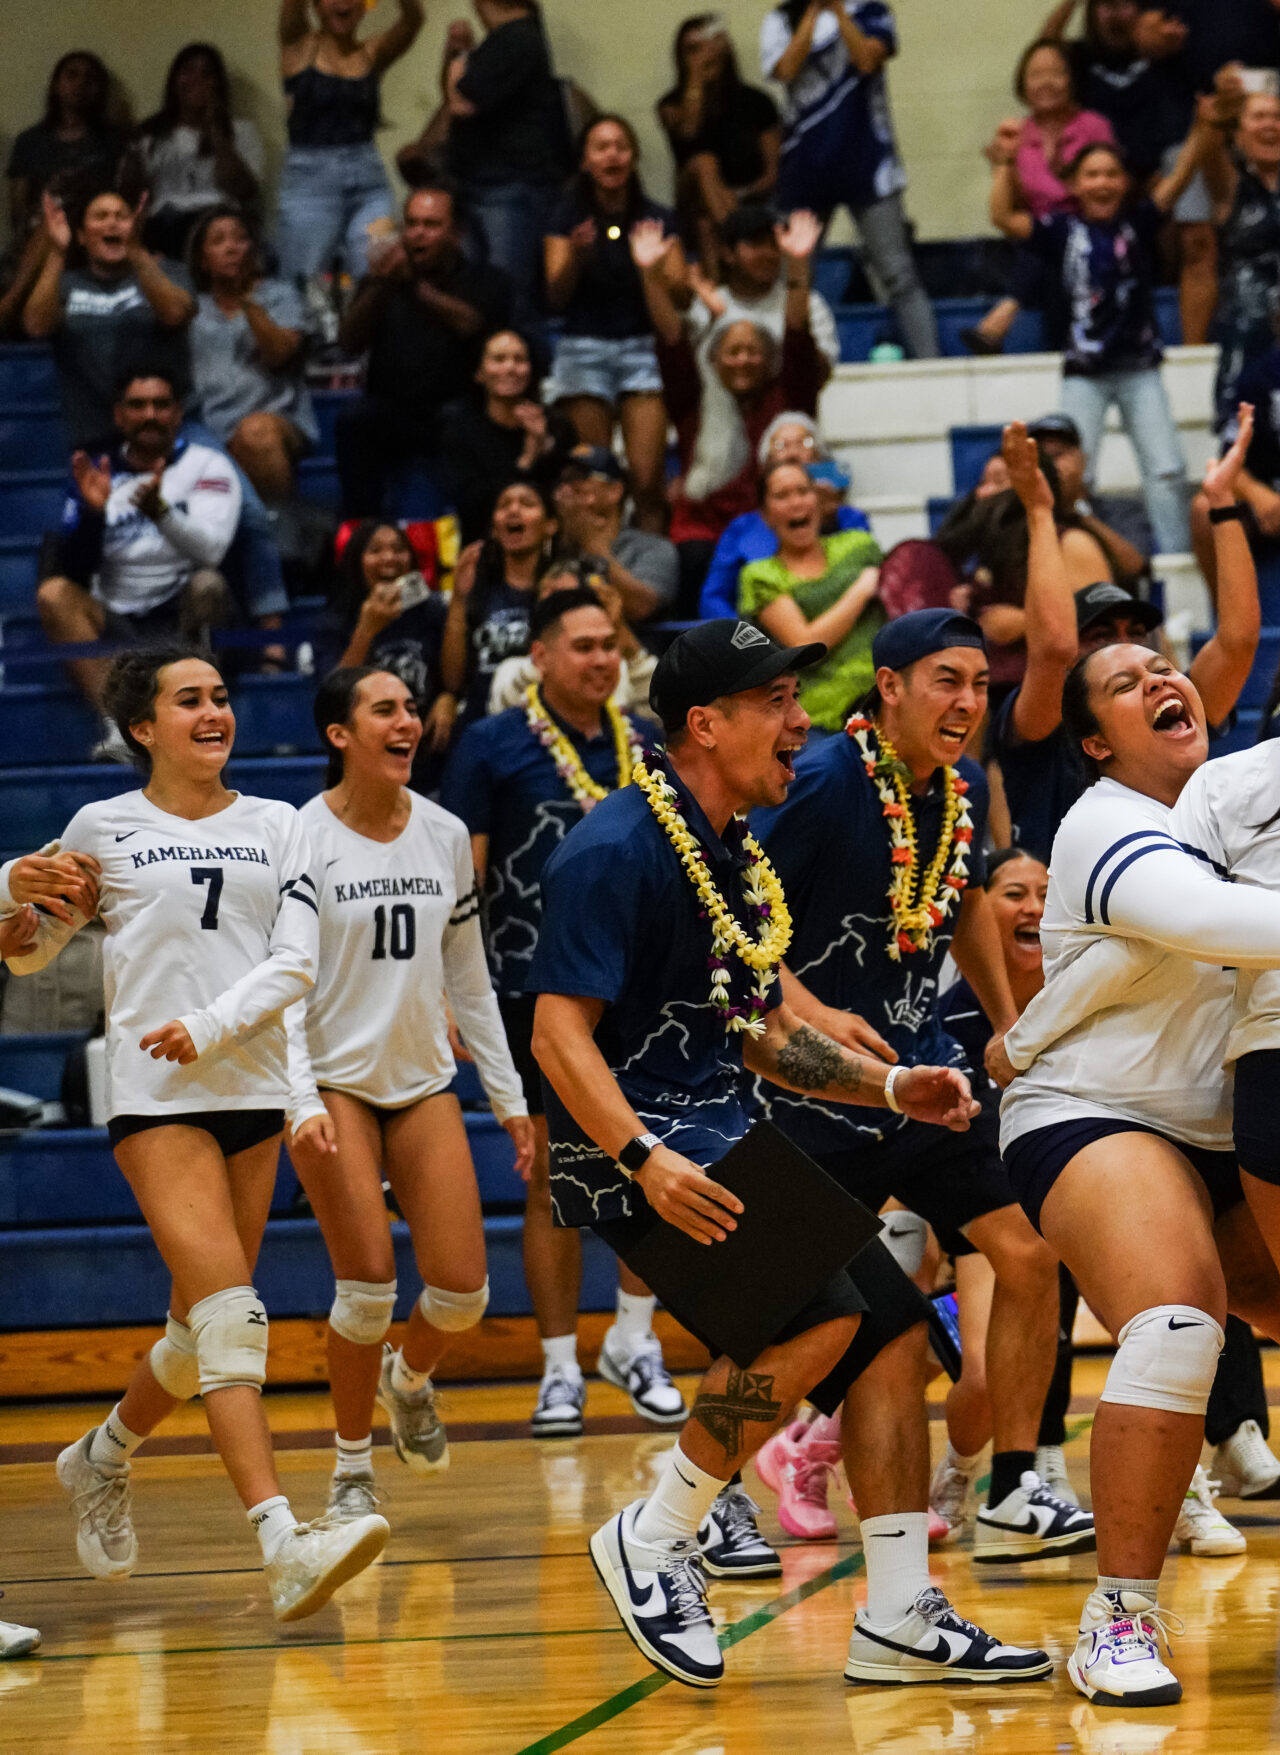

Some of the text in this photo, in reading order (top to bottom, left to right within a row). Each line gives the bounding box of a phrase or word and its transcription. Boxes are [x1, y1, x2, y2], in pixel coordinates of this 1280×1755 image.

[131, 846, 270, 869] KAMEHAMEHA
[190, 867, 224, 931] 7
[335, 877, 444, 903] KAMEHAMEHA
[371, 903, 416, 961] 10
